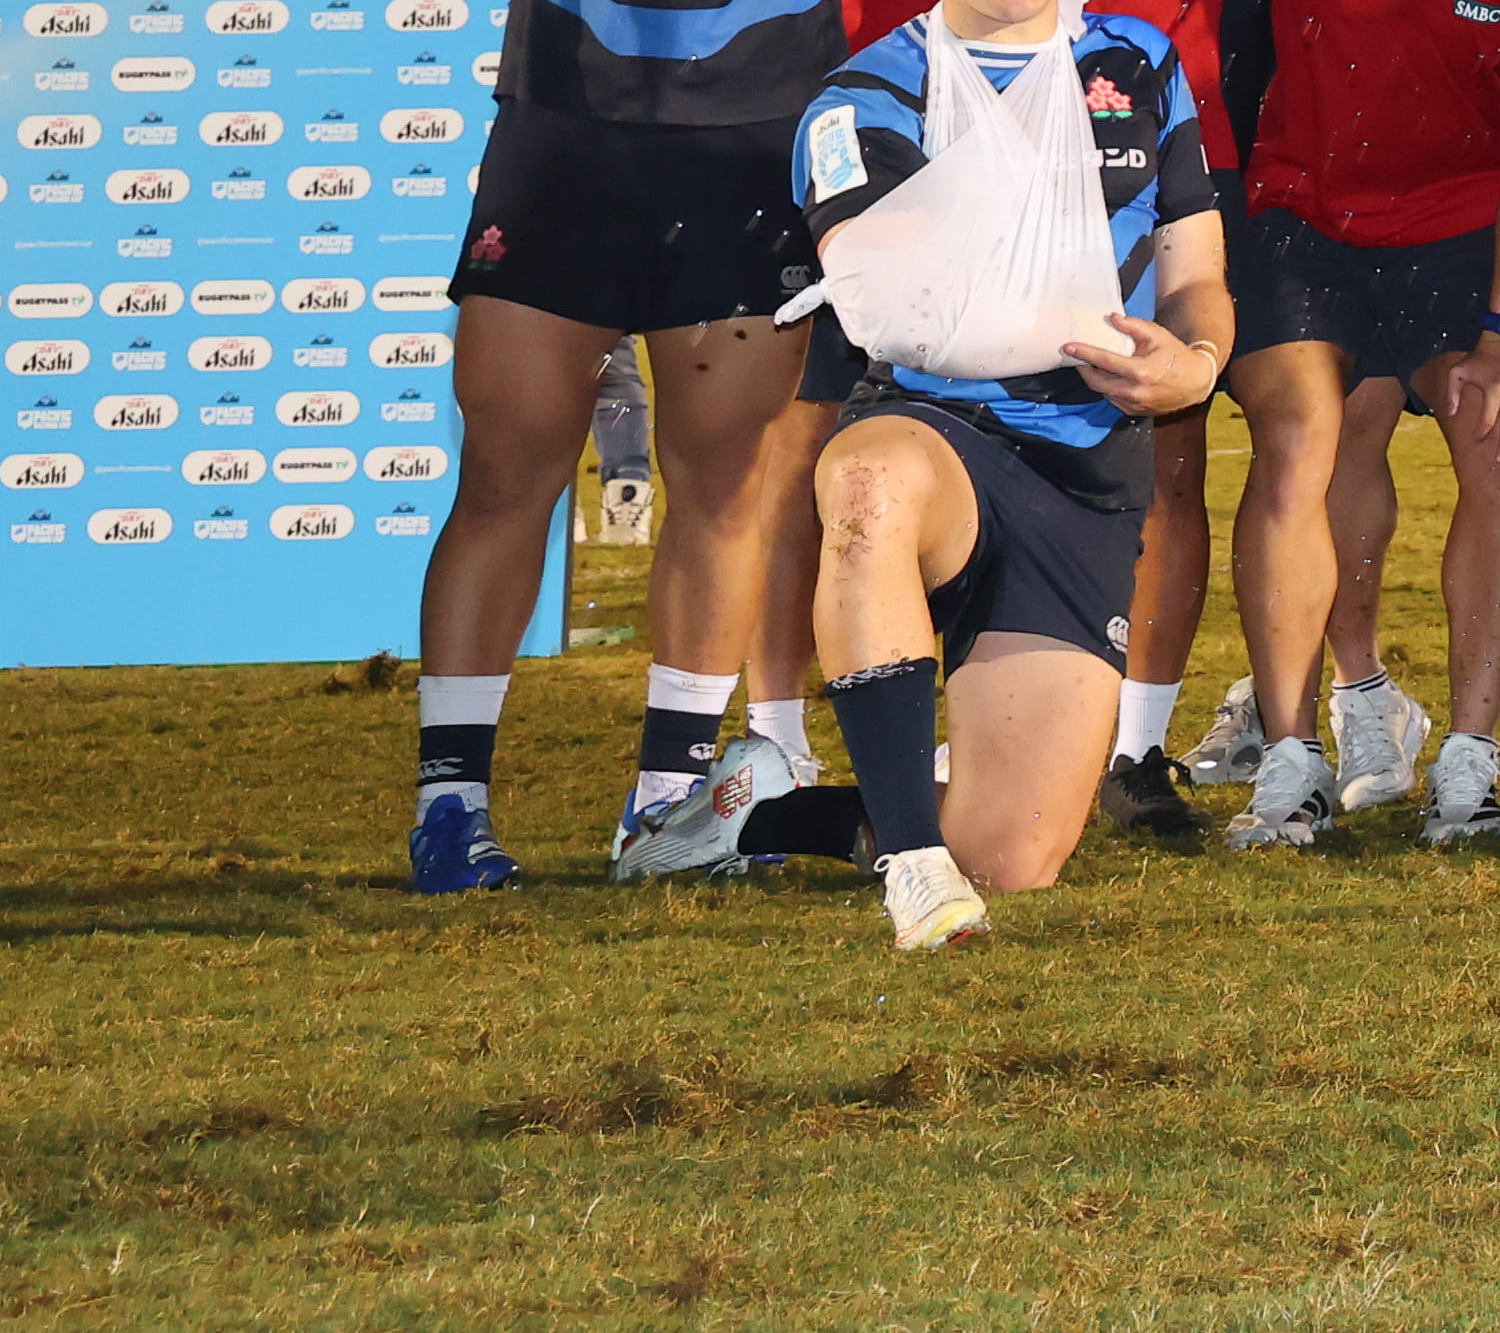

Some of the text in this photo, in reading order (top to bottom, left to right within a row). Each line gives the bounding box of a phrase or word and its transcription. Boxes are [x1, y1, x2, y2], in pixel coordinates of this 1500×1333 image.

[41, 15, 90, 33] Asahi
[223, 12, 272, 31] Asahi
[403, 9, 451, 27] Asahi
[35, 126, 84, 145] Asahi
[217, 124, 266, 142] Asahi
[398, 121, 446, 139] Asahi
[123, 181, 173, 200] Asahi
[304, 178, 354, 197] Asahi
[117, 294, 167, 313] Asahi
[299, 290, 348, 309] Asahi
[23, 351, 73, 371] Asahi
[205, 349, 255, 367] Asahi
[386, 345, 436, 364] Asahi
[112, 406, 161, 426] Asahi
[293, 404, 342, 422] Asahi
[16, 465, 67, 485] Asahi
[199, 462, 249, 481] Asahi
[381, 458, 430, 477] Asahi
[105, 520, 155, 540] Asahi
[287, 517, 337, 536] Asahi
